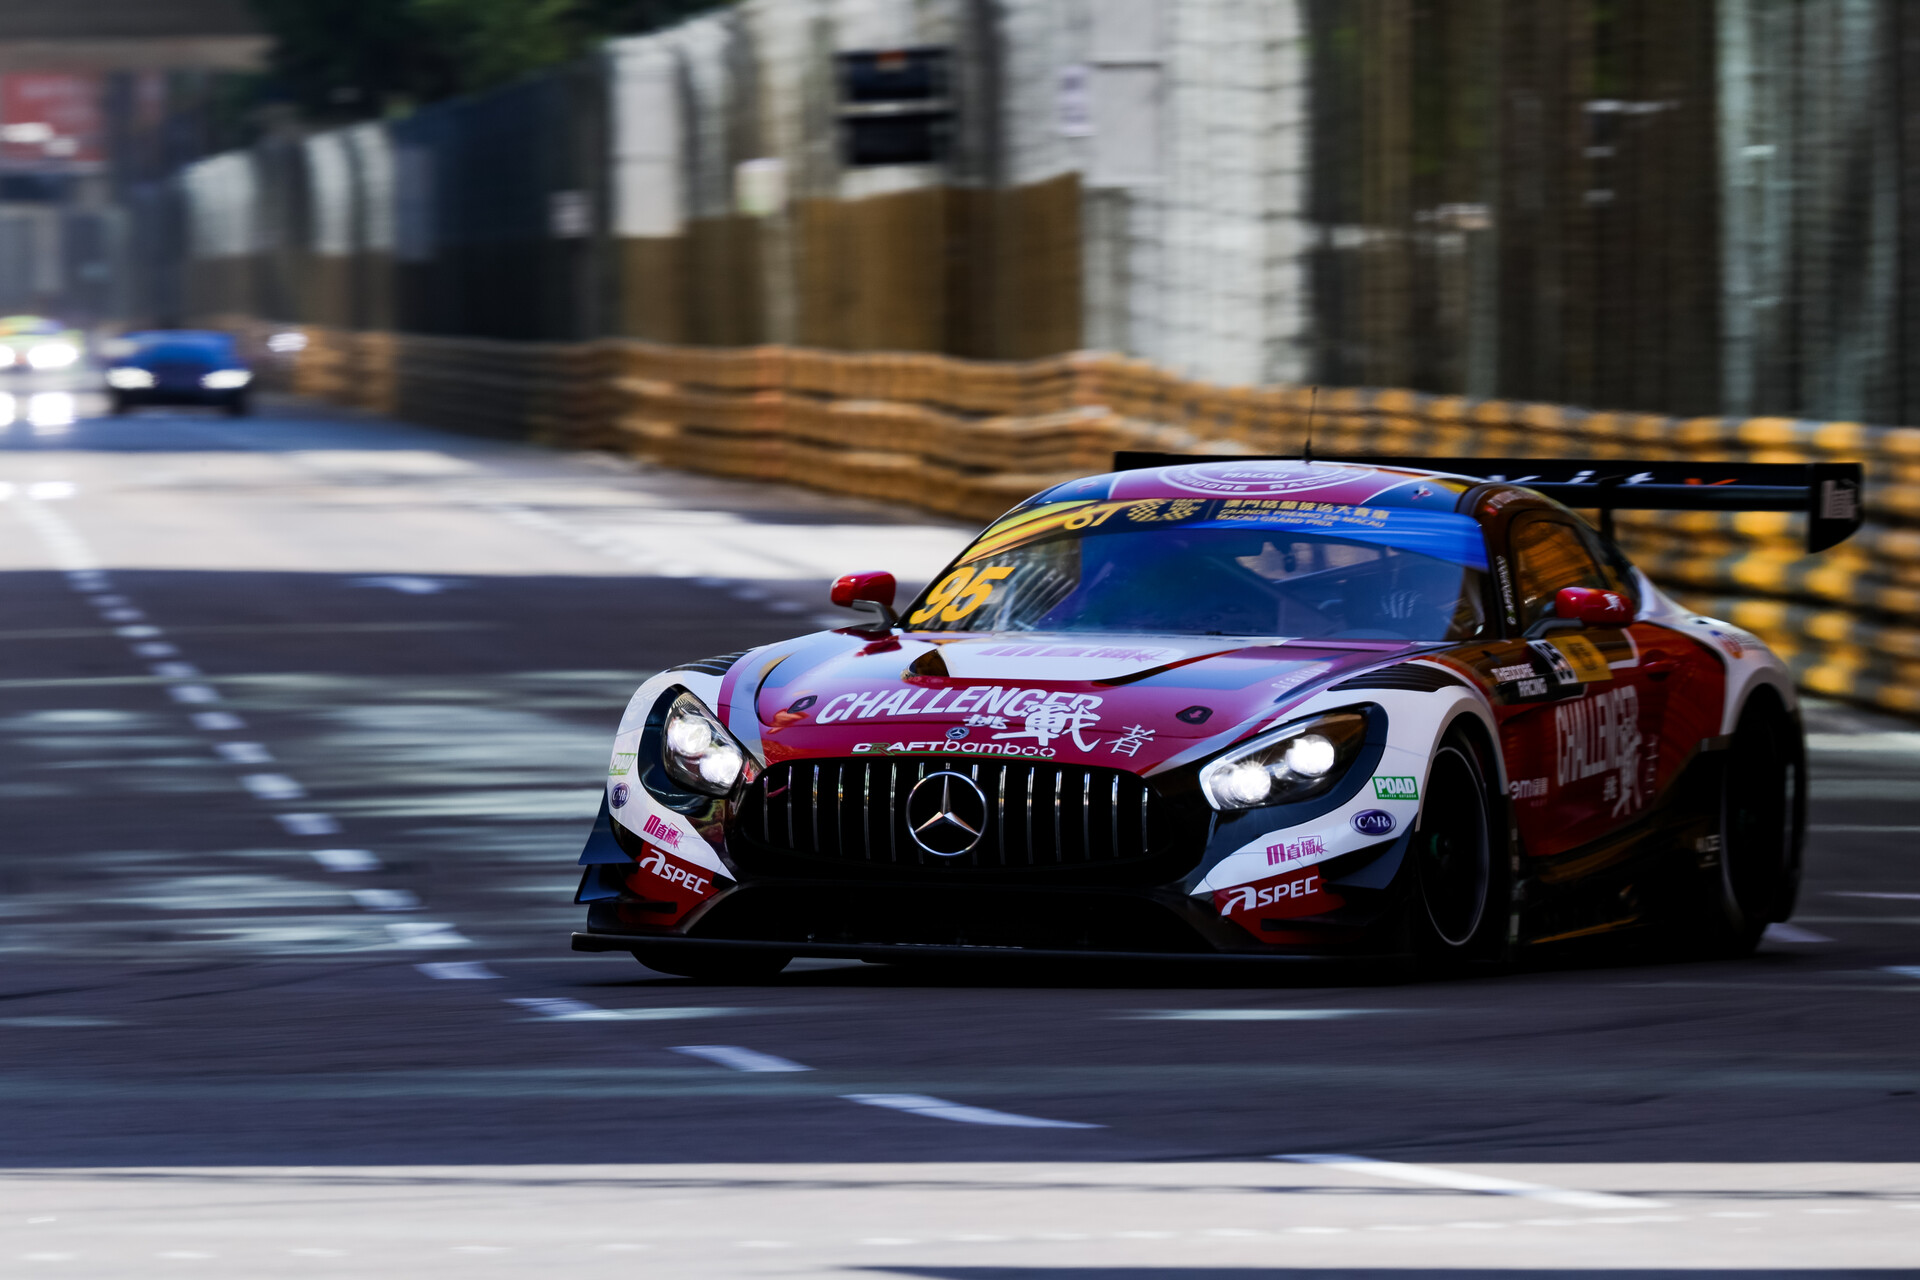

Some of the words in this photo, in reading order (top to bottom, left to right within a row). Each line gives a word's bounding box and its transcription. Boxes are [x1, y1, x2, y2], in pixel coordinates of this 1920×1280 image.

[1221, 472, 1289, 480] MACAU
[1218, 508, 1271, 516] GRANDE
[1323, 513, 1341, 521] DE
[1342, 516, 1386, 528] MACAU
[1259, 515, 1304, 524] GRAND
[1305, 519, 1334, 527] PRIX
[909, 566, 1015, 625] 95
[1518, 678, 1548, 697] RACING
[816, 686, 1103, 724] CHALLENGER
[1374, 777, 1416, 794] POAD
